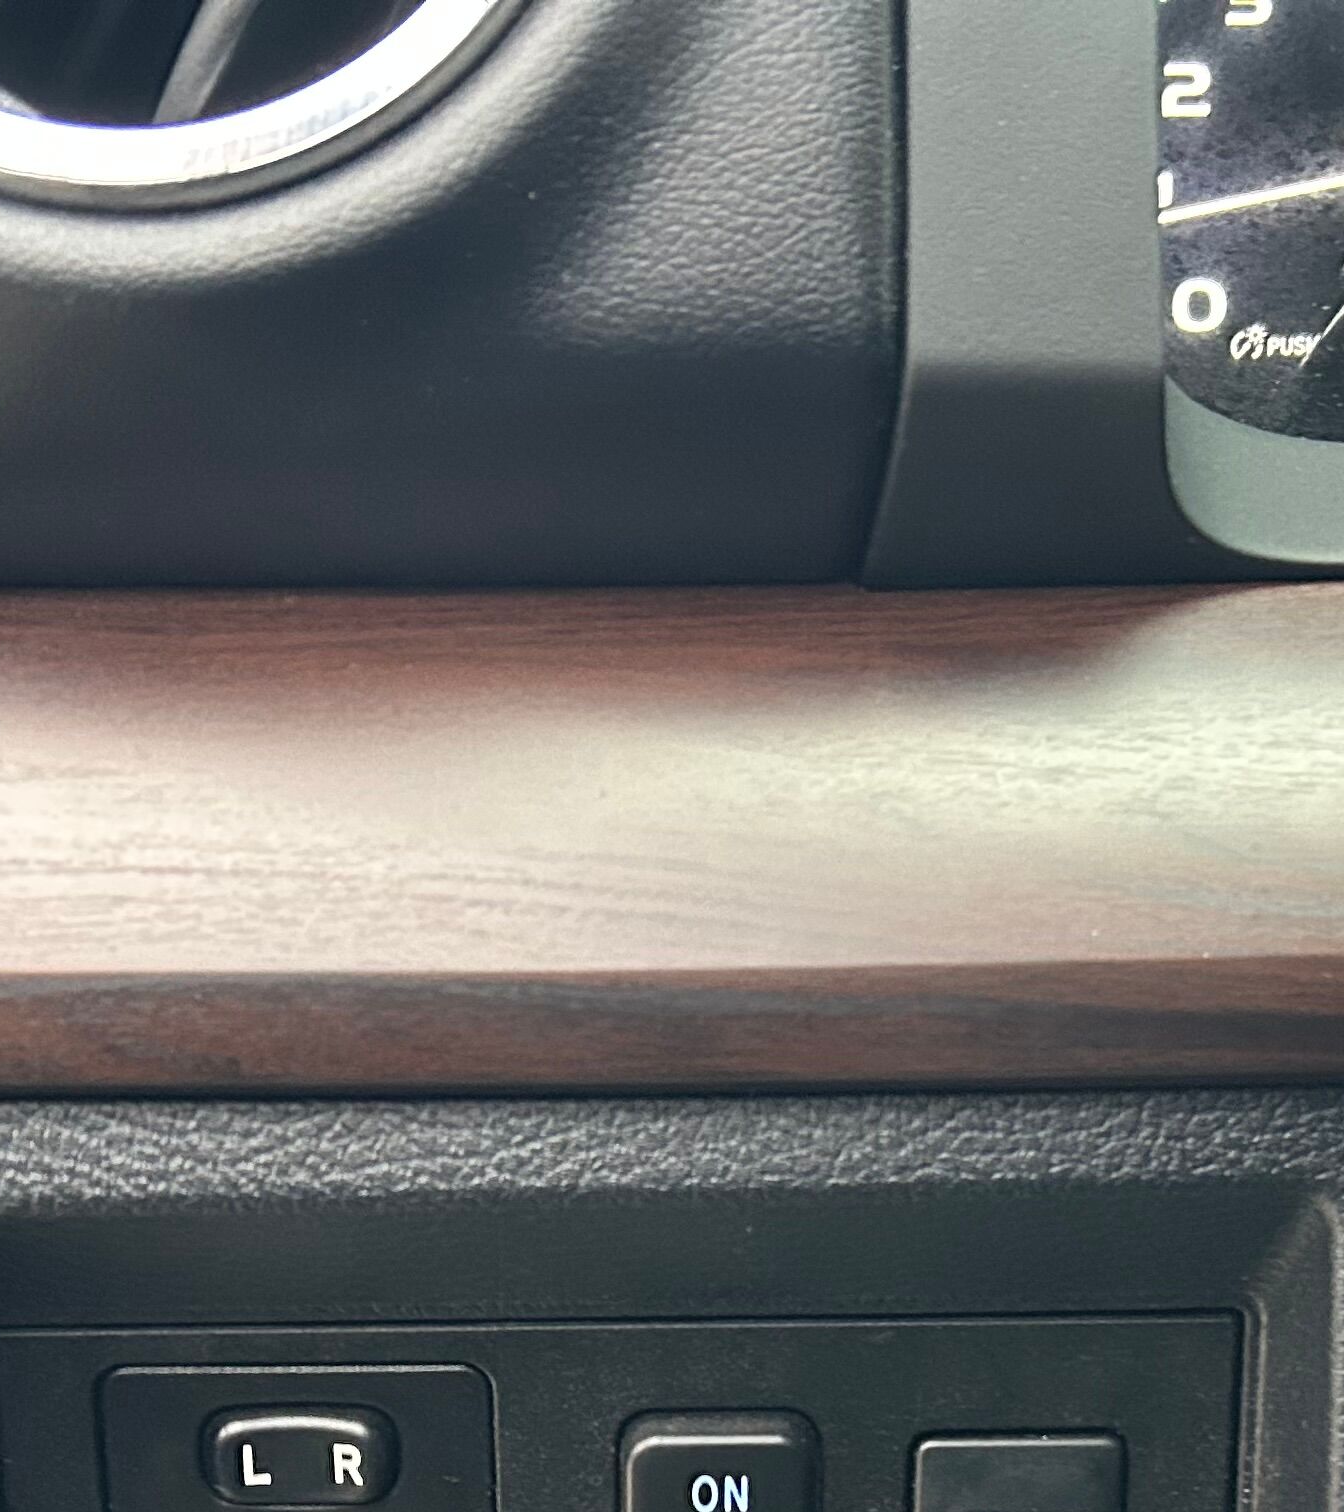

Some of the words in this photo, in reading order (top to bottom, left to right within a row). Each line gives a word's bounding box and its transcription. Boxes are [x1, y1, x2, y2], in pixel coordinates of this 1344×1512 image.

[1160, 61, 1212, 118] 2
[1171, 275, 1228, 333] 0
[242, 1444, 272, 1487] L
[331, 1444, 365, 1488] R
